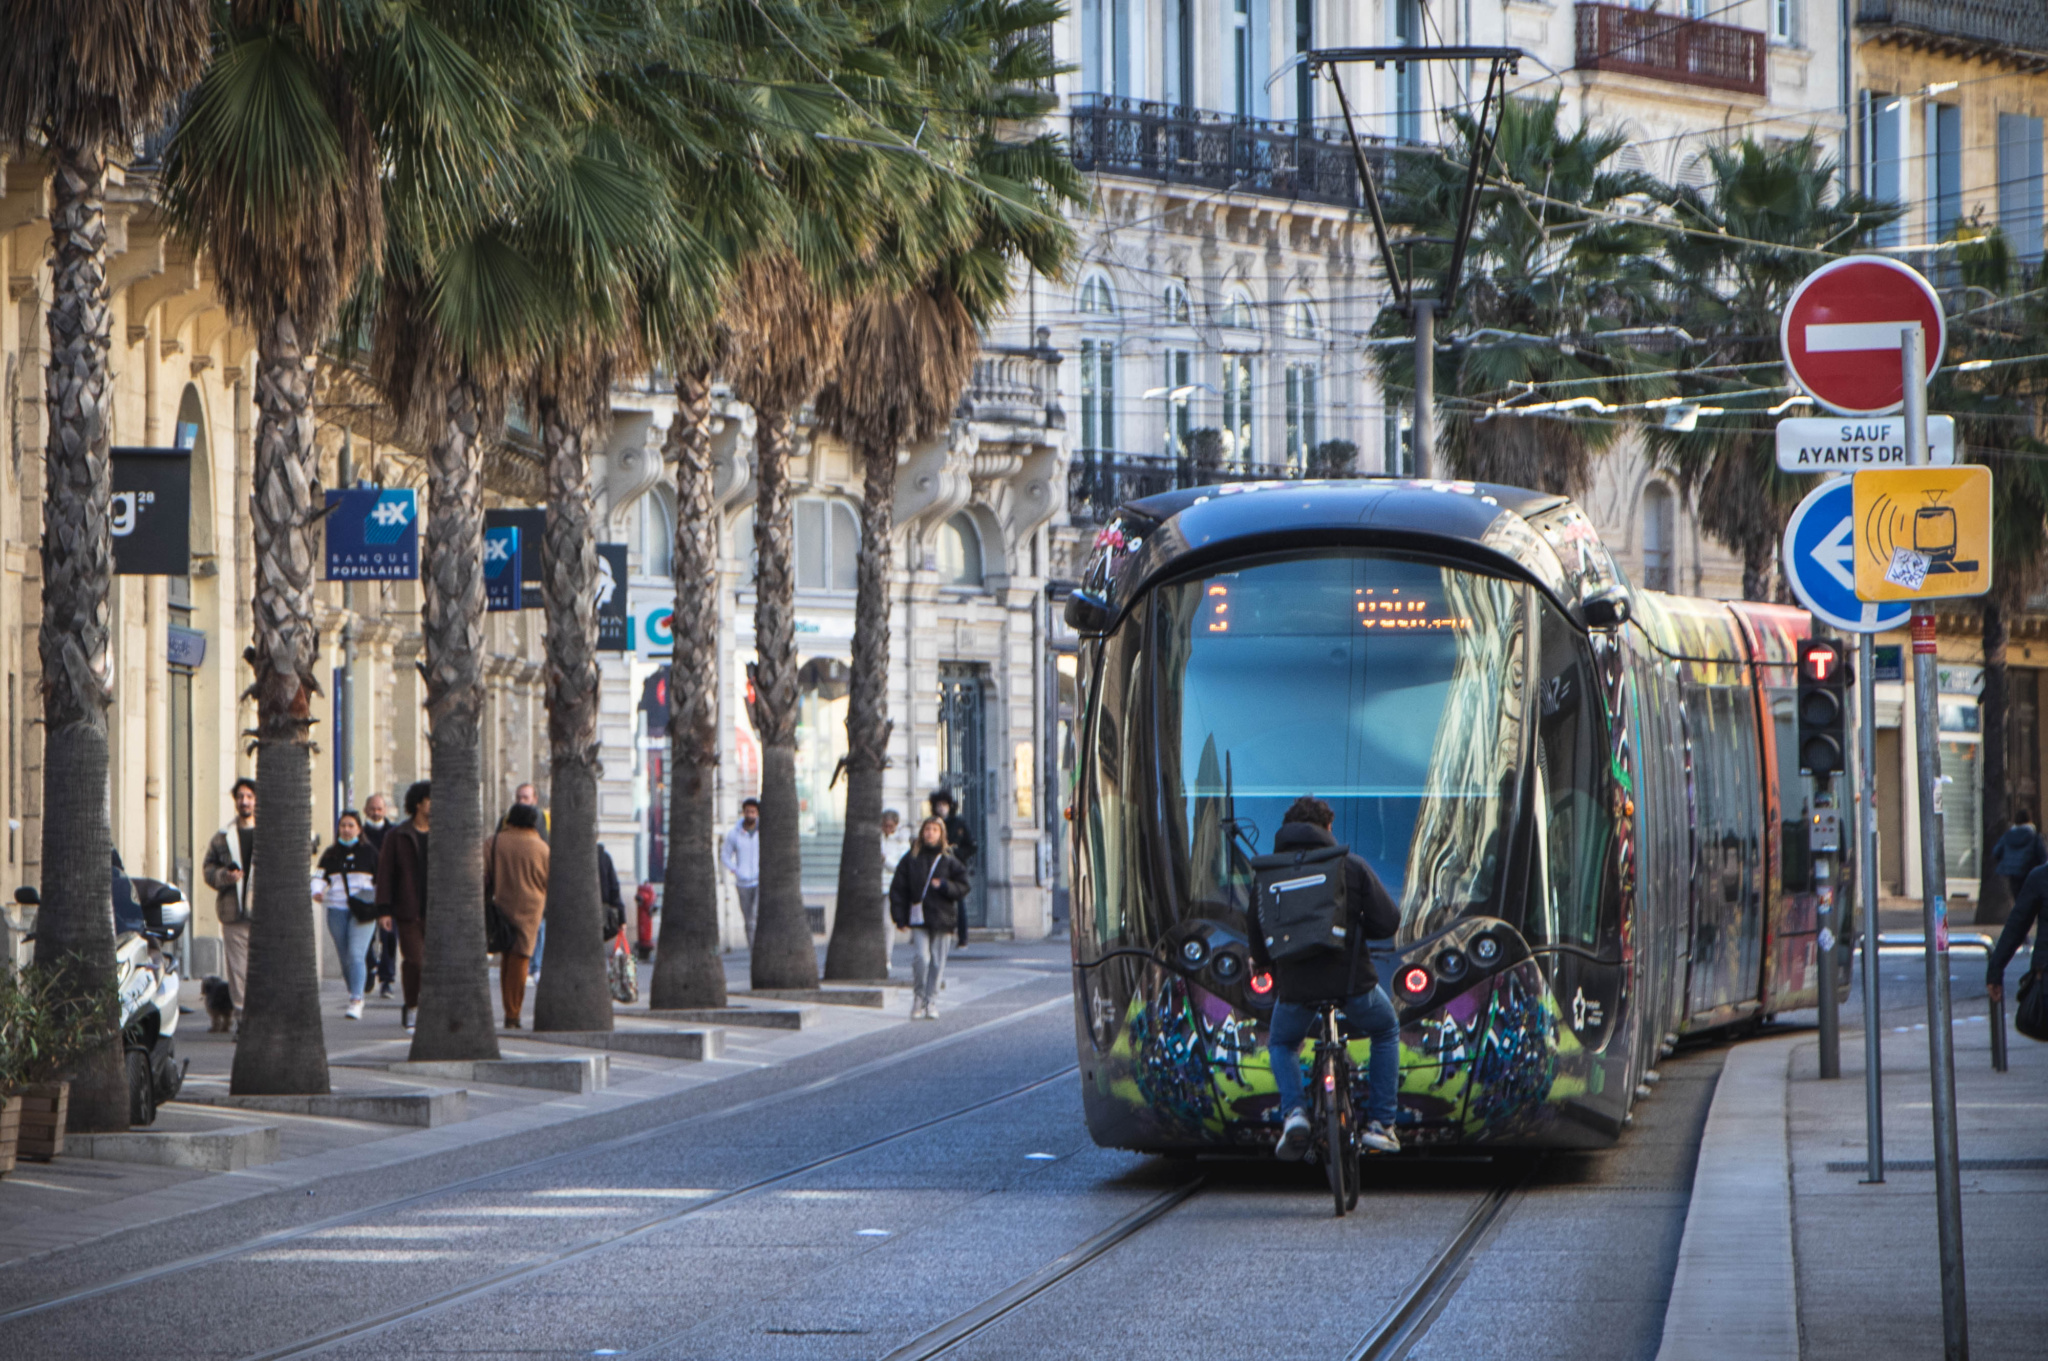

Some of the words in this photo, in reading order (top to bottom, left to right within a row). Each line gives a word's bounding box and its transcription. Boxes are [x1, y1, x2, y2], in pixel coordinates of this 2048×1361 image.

[1841, 425, 1891, 442] SAUF
[1798, 446, 1874, 464] AYANTS
[1879, 445, 1935, 462] DRT
[332, 553, 409, 564] BANQUE
[332, 565, 410, 576] POPULAIRE
[1808, 651, 1832, 679] T
